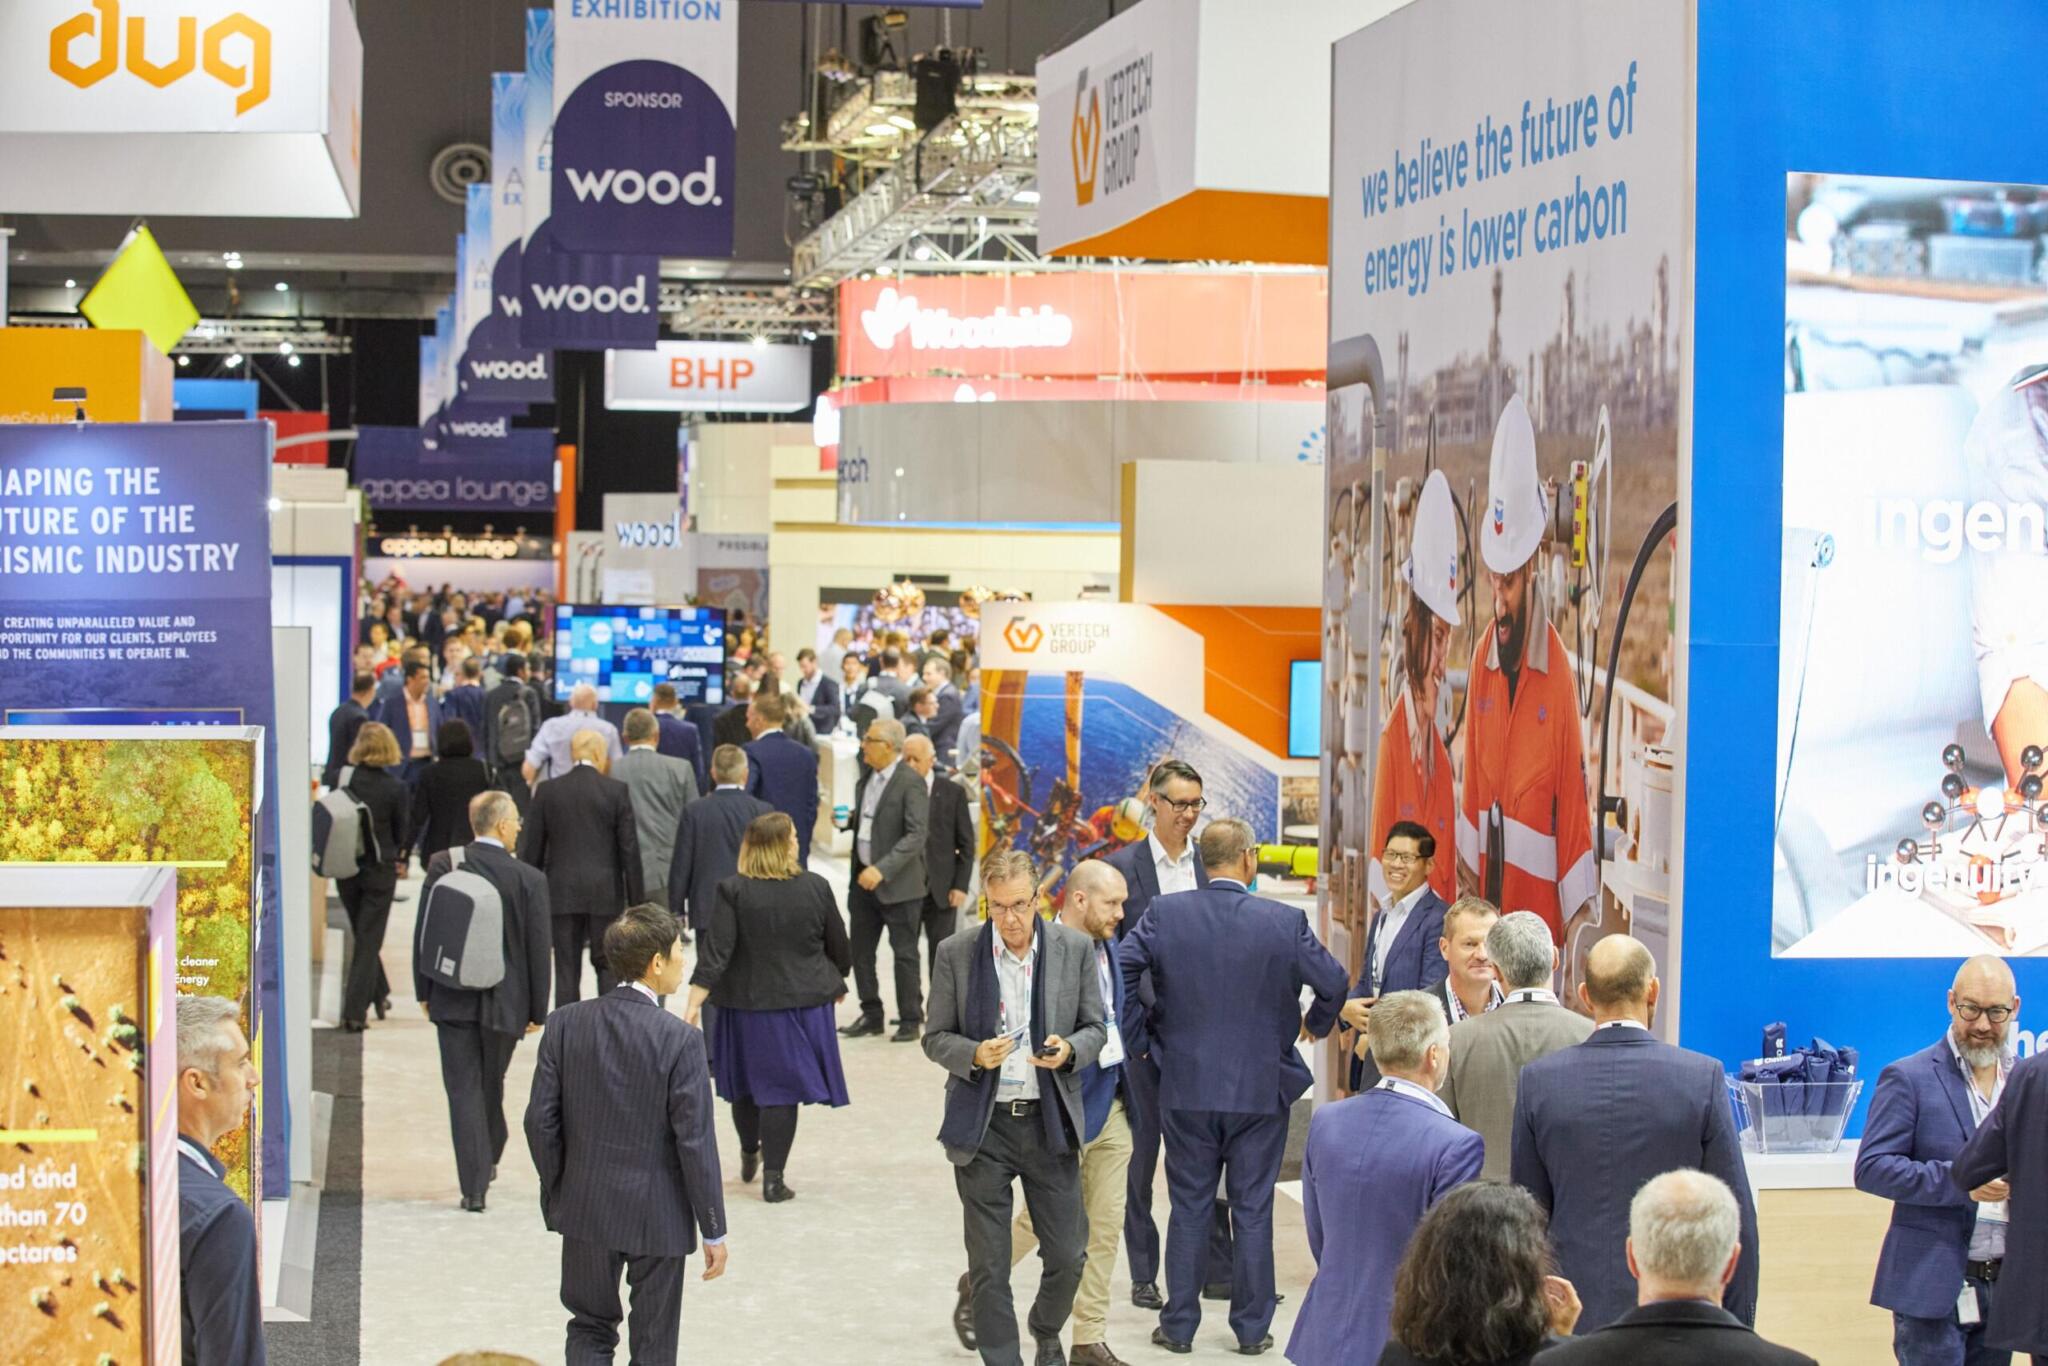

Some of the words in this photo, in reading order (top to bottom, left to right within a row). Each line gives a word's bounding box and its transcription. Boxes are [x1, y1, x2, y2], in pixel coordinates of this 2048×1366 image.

[572, 0, 721, 21] EXHIBITION
[50, 0, 271, 116] dug
[604, 92, 682, 109] SPONSOR
[1104, 52, 1152, 132] VERTECH
[1361, 170, 1388, 219] we
[1395, 137, 1468, 209] believe
[1476, 115, 1514, 181] the
[1521, 93, 1599, 166] future
[1608, 61, 1637, 140] of
[1104, 124, 1140, 195] GROUP
[565, 155, 722, 206] wood.
[1365, 233, 1432, 296] energy
[1440, 214, 1455, 275] is
[1462, 205, 1527, 270] lower
[1534, 175, 1628, 255] carbon
[532, 275, 650, 314] wood.
[669, 357, 755, 390] BHP
[104, 466, 161, 496] THE
[360, 477, 449, 504] appea
[456, 475, 549, 507] lounge
[91, 507, 128, 535] OF
[139, 505, 195, 534] THE
[96, 543, 240, 573] INDUSTRY
[381, 537, 448, 558] appea
[449, 536, 518, 559] lounge
[4, 617, 54, 629] CREATING
[57, 617, 135, 629] UNPARALLELED
[138, 616, 171, 628] VALUE
[173, 615, 196, 628] AND
[1049, 623, 1111, 638] VERTECH
[62, 632, 82, 644] FOR
[85, 632, 107, 644] OUR
[110, 632, 155, 645] CLIENTS,
[158, 631, 218, 643] EMPLOYEES
[1050, 639, 1097, 654] GROUP
[13, 648, 32, 660] THE
[35, 648, 105, 660] COMMUNITIES
[108, 648, 124, 660] WE
[126, 648, 171, 660] OPERATE
[174, 647, 190, 659] IN.
[180, 955, 219, 967] cleaner
[32, 1163, 77, 1190] and
[54, 1202, 87, 1227] 70
